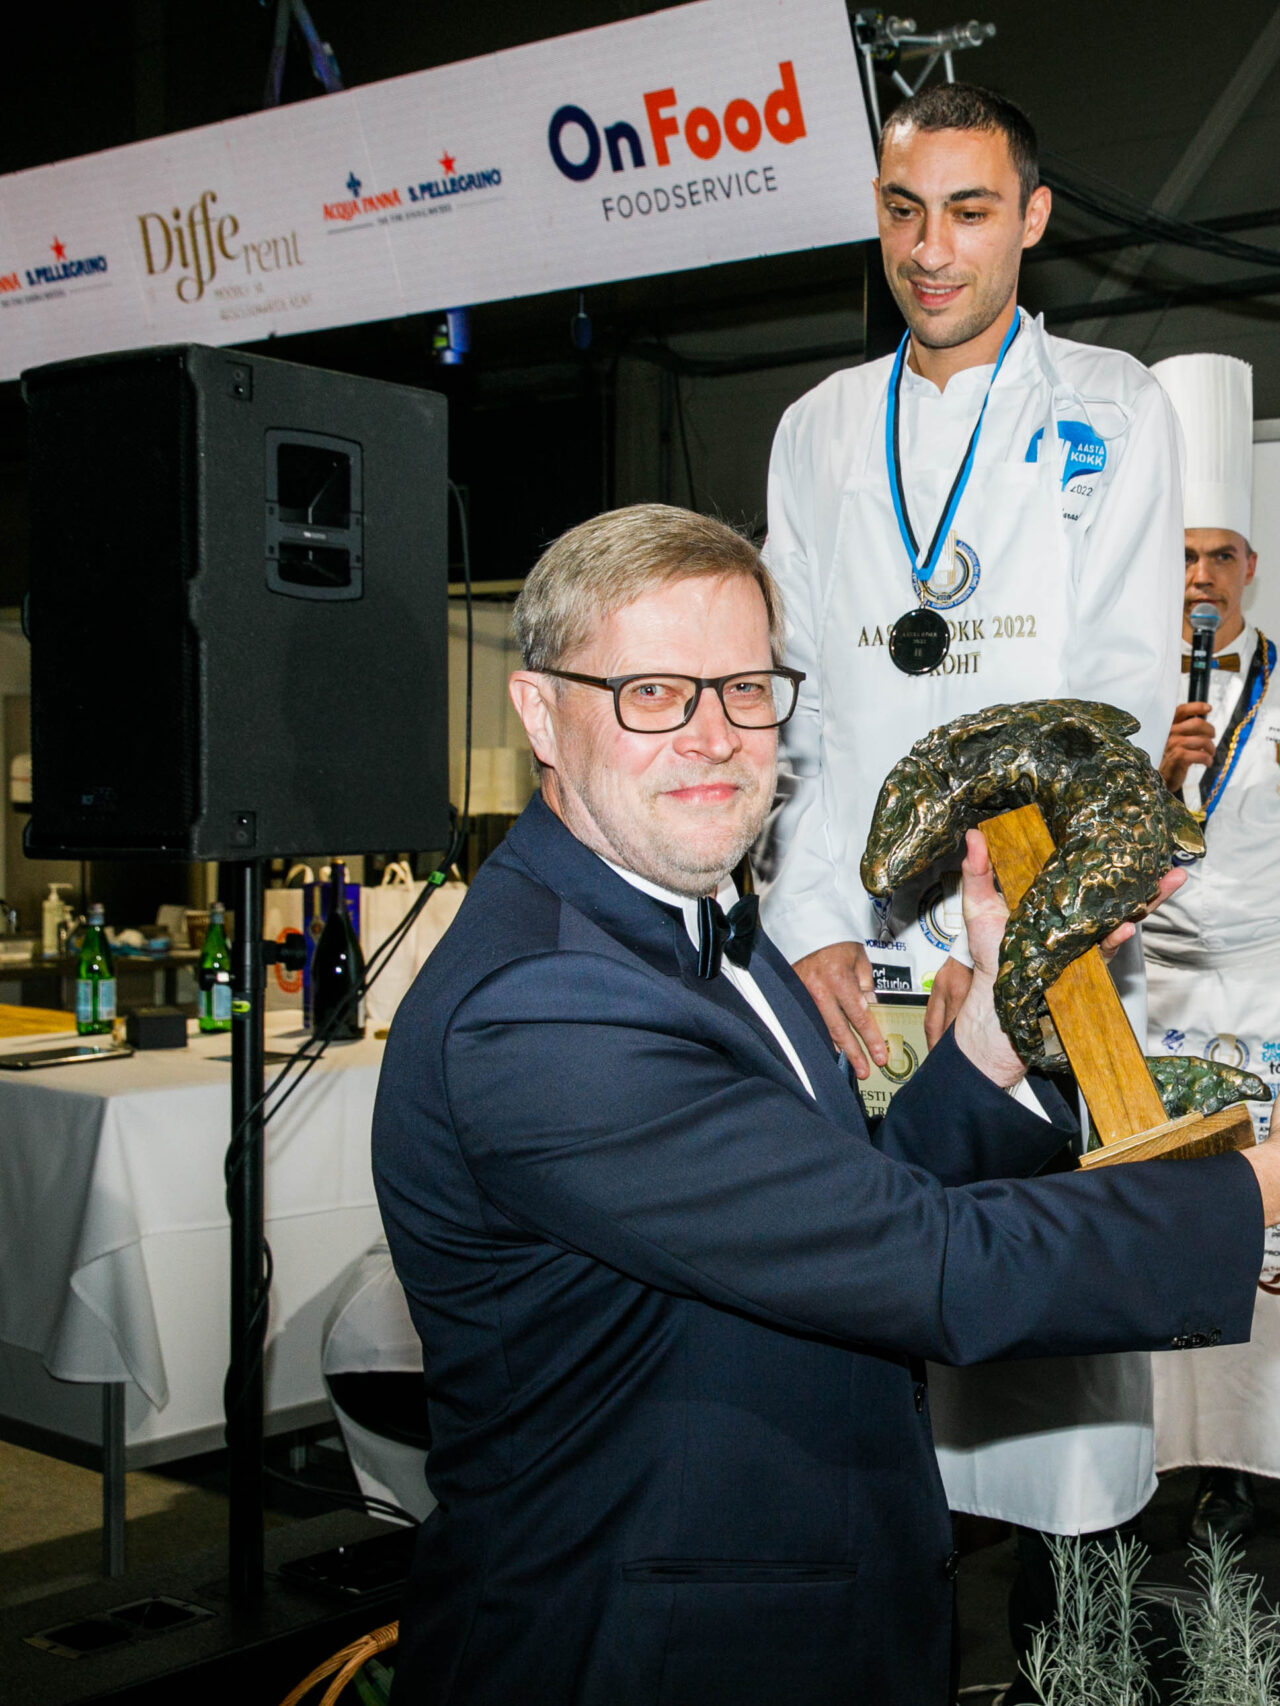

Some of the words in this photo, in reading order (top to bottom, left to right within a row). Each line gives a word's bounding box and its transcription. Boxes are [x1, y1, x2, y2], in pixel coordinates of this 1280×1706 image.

[547, 60, 808, 183] OnFood
[601, 166, 778, 222] FOODSERVICE
[1077, 443, 1105, 455] AASTA
[1070, 452, 1104, 467] KOKK
[992, 614, 1037, 639] 2022
[860, 1090, 887, 1102] ESTI
